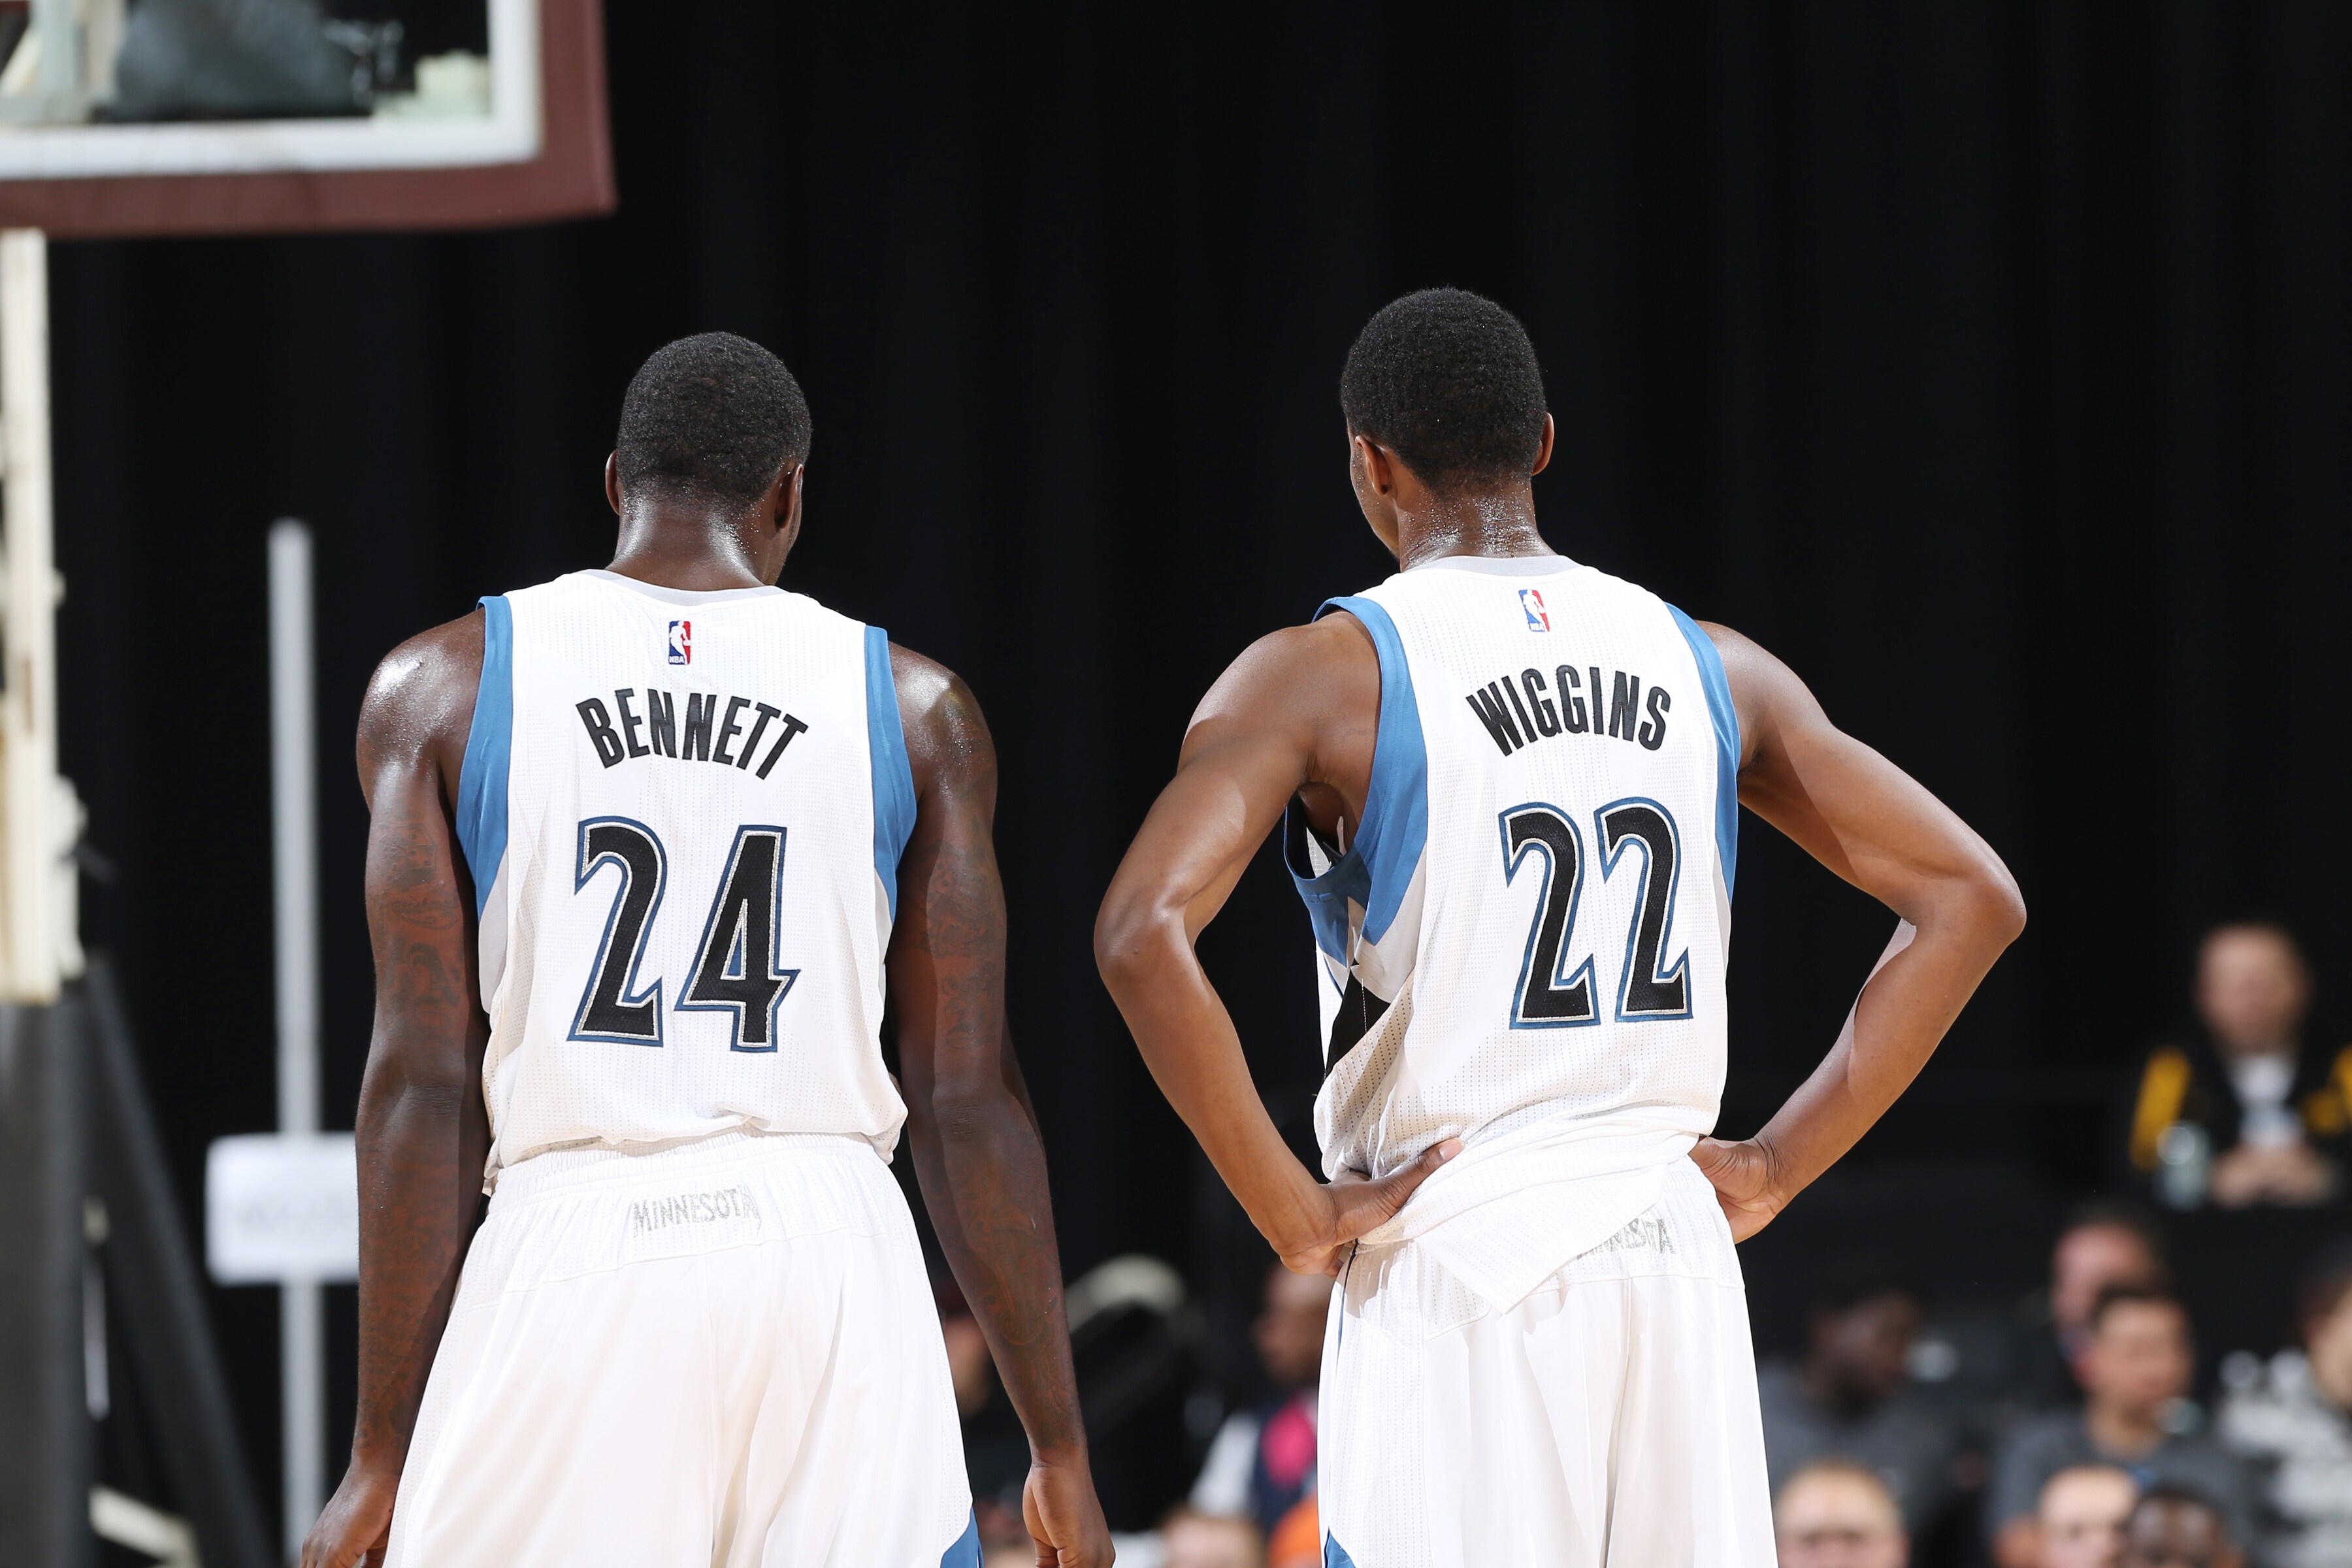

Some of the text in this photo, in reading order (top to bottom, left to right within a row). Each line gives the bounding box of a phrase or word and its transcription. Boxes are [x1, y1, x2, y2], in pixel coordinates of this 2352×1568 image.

[576, 688, 808, 780] BENNETT
[1466, 665, 1671, 756] WIGGINS
[566, 816, 801, 1053] 24
[1498, 797, 1693, 1030] 22
[633, 1184, 760, 1239] MINNESOTA
